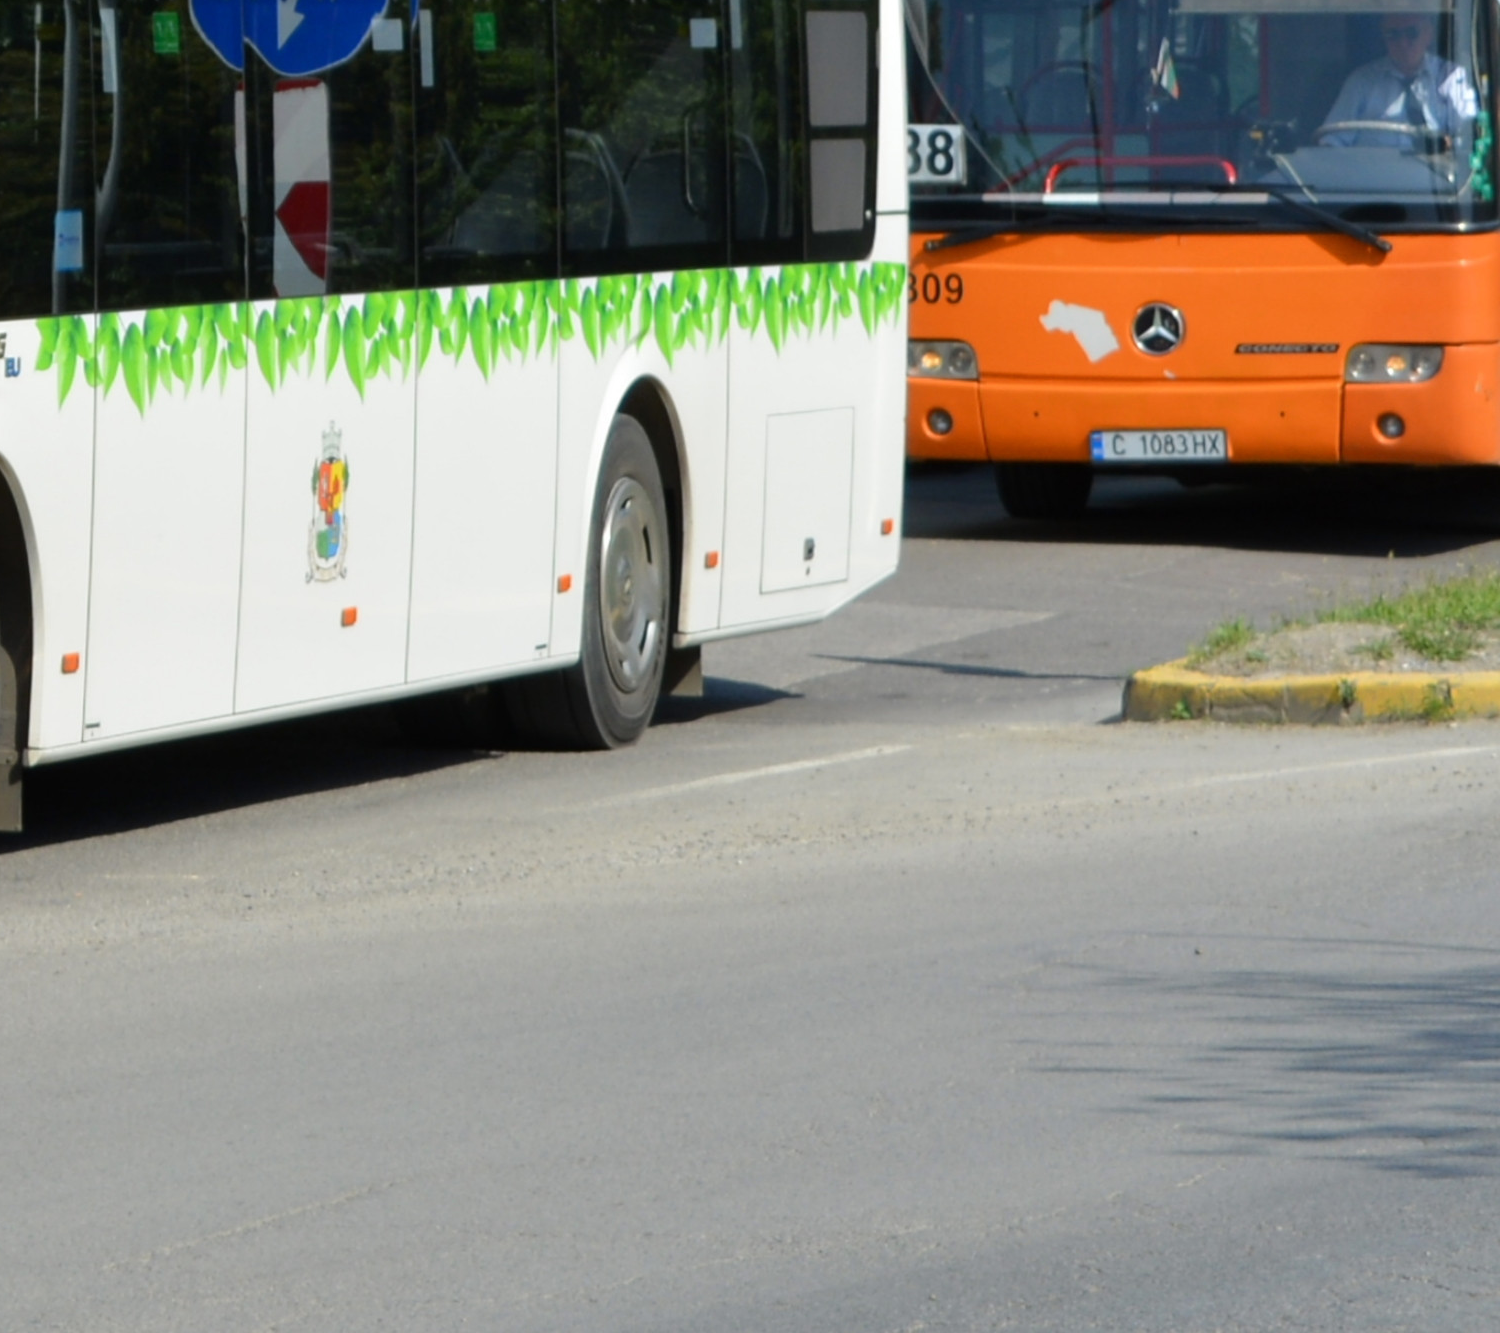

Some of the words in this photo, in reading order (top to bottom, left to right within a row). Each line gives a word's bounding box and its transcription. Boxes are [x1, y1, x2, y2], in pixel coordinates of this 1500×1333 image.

[1112, 433, 1127, 455] C
[1140, 433, 1189, 455] 1083
[1193, 433, 1221, 455] HX
